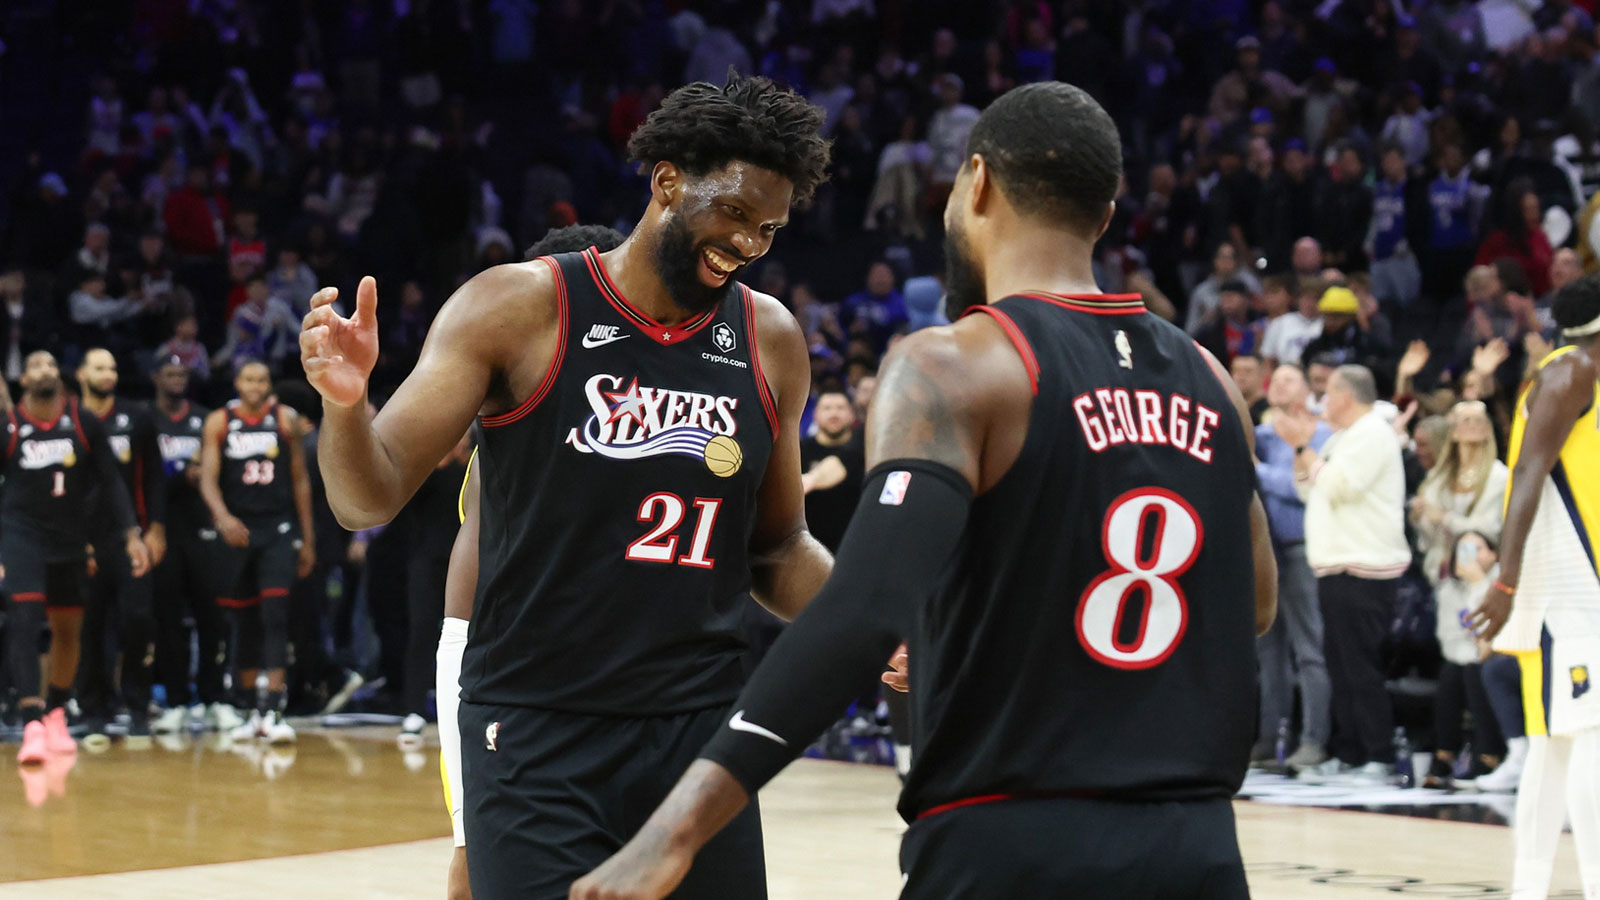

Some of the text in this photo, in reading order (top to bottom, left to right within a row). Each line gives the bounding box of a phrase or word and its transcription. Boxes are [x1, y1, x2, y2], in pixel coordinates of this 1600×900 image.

[588, 324, 620, 340] NIKE
[701, 351, 747, 369] crypto.com
[566, 373, 738, 459] SIXERS
[1072, 386, 1221, 465] GEORGE
[51, 471, 67, 497] 1
[242, 460, 275, 485] 33
[625, 491, 723, 569] 21
[1074, 486, 1205, 671] 8
